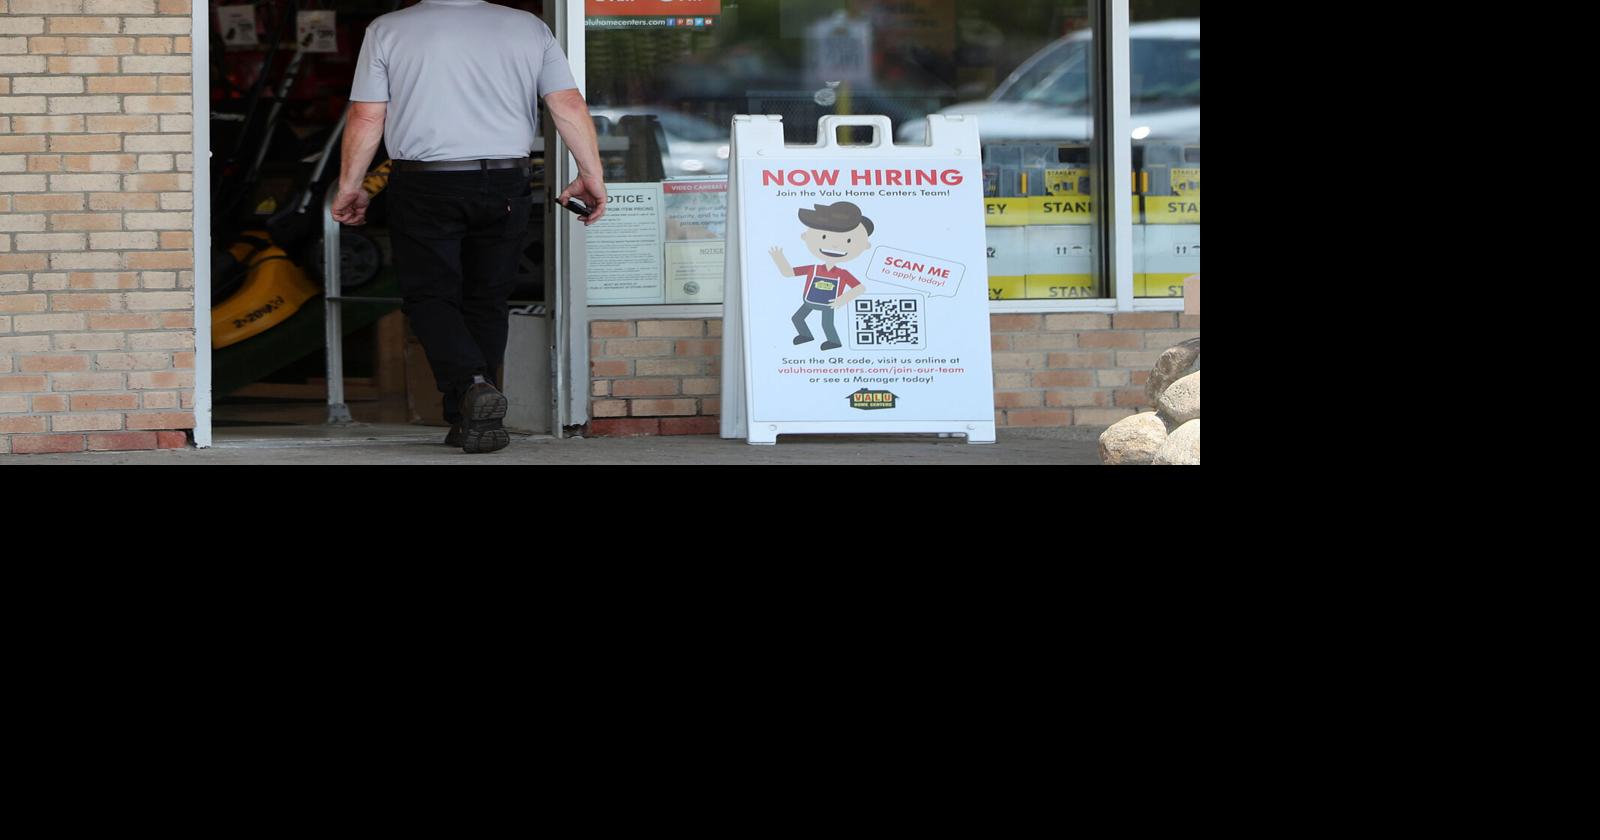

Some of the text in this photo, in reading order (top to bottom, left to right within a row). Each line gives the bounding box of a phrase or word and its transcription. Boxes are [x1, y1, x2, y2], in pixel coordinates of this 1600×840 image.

[584, 18, 665, 26] aluhomecenters.com
[762, 169, 964, 187] NOW HIRING
[878, 189, 917, 197] Centers
[920, 189, 950, 197] Team!
[607, 194, 644, 204] OTICE
[884, 256, 951, 279] SCAN ME
[881, 267, 946, 287] to apply today!
[782, 357, 806, 365] Scan
[809, 357, 825, 365] the
[828, 357, 844, 365] QR
[847, 357, 874, 366] code,
[877, 357, 898, 365] visit
[915, 357, 947, 365] online
[950, 357, 960, 365] at
[778, 366, 965, 375] valuhomecenters.com/join-our-team
[853, 376, 900, 384] Manager
[902, 376, 934, 384] today!
[854, 393, 892, 401] VALU
